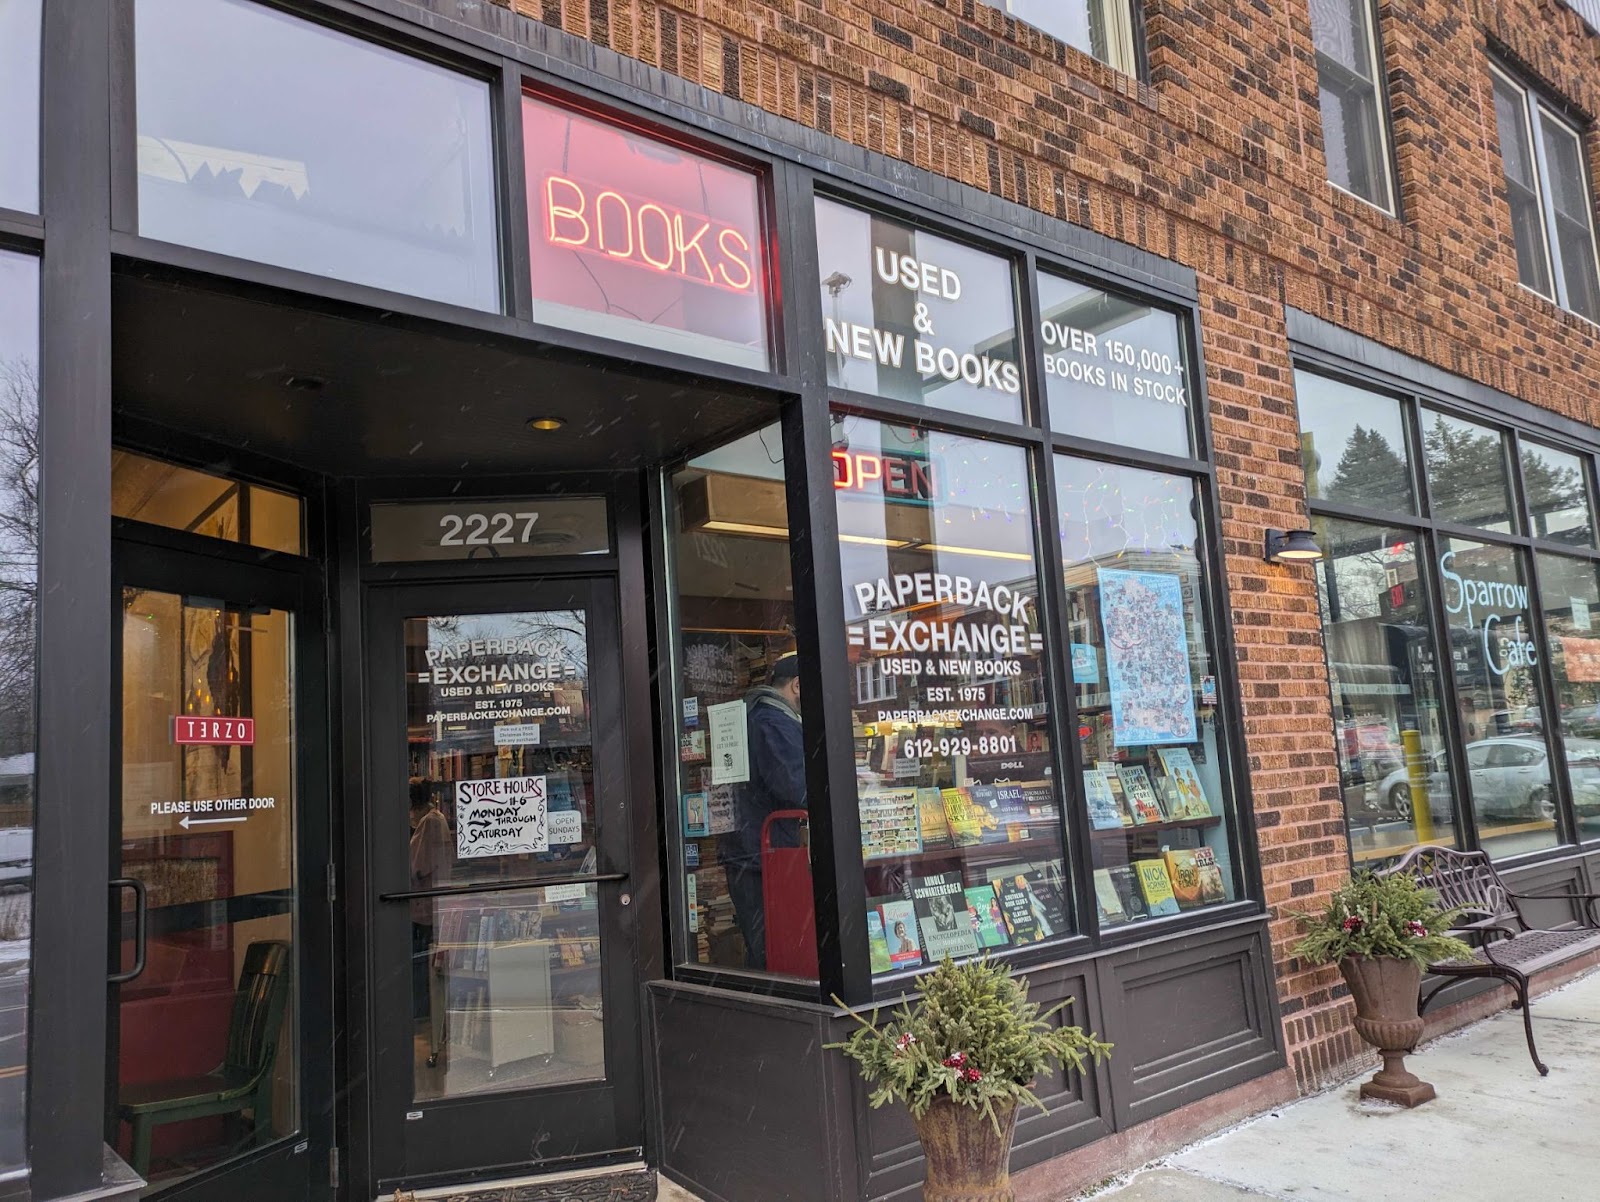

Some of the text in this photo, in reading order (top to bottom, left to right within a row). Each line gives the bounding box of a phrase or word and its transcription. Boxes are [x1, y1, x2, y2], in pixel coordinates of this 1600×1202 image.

[546, 176, 751, 290] BOOKS
[875, 246, 961, 301] USED
[913, 302, 935, 337] &
[825, 318, 1020, 395] NEW BOOKS
[1041, 320, 1184, 377] OVER 150,000+
[1043, 353, 1188, 407] BOOKS IN STOCK
[439, 512, 539, 547] 2227
[854, 572, 1033, 625] PAPERBACK
[1440, 551, 1528, 630] Sparrow
[425, 637, 567, 667] PAPERBACK
[1484, 613, 1538, 675] Cafe
[880, 658, 1021, 676] USED & NEW BOOKS
[441, 682, 555, 697] USED & NEW BOOKS
[926, 687, 986, 701] EST. 1975
[475, 699, 522, 710] EST. 1975
[426, 706, 570, 723] PAPERBACKEXCHANGE.COM
[877, 707, 1033, 723] PAPERBACKEXCHANGE.COM
[904, 735, 1017, 759] 612-929-8801
[459, 778, 543, 804] STORE HOURS
[997, 788, 1021, 800] ISRAEL
[151, 797, 275, 814] PLEASE USE OTHER DOOR
[469, 807, 521, 820] MONDAY
[495, 815, 536, 825] THROUGH
[555, 817, 575, 825] OPEN
[468, 827, 523, 843] SATURDAY
[548, 826, 580, 835] SUNDAYS
[559, 835, 574, 843] 12-5
[1142, 866, 1167, 881] NICK
[928, 929, 972, 942] ENCYCLOPEDIA
[932, 943, 975, 957] BODBUILDING
